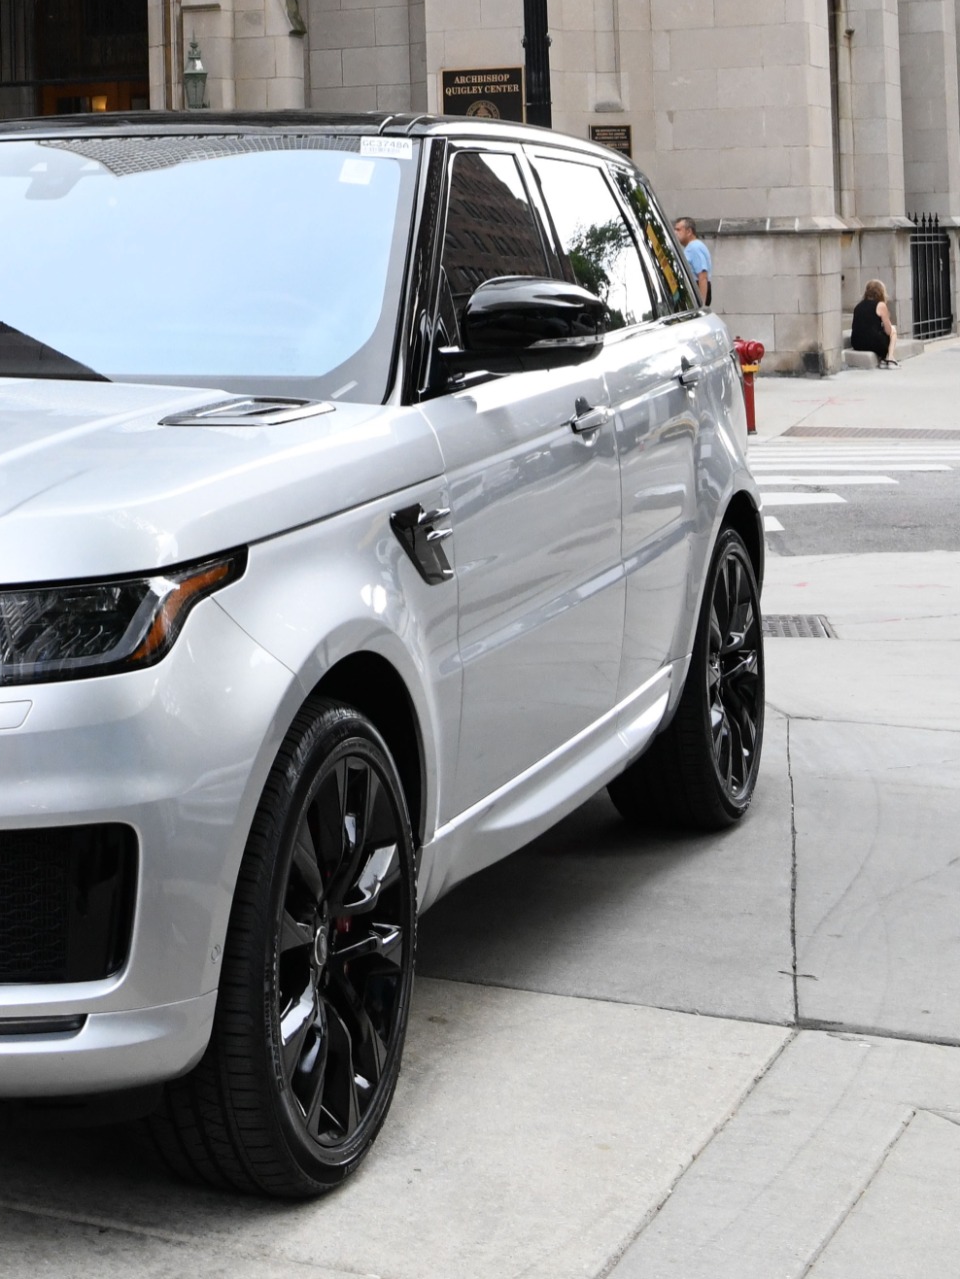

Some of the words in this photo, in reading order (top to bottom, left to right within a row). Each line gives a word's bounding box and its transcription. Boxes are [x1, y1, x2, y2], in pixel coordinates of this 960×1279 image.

[454, 73, 510, 84] ARCHBISHOP
[445, 85, 483, 96] QUIGLEY
[484, 84, 519, 94] CENTER
